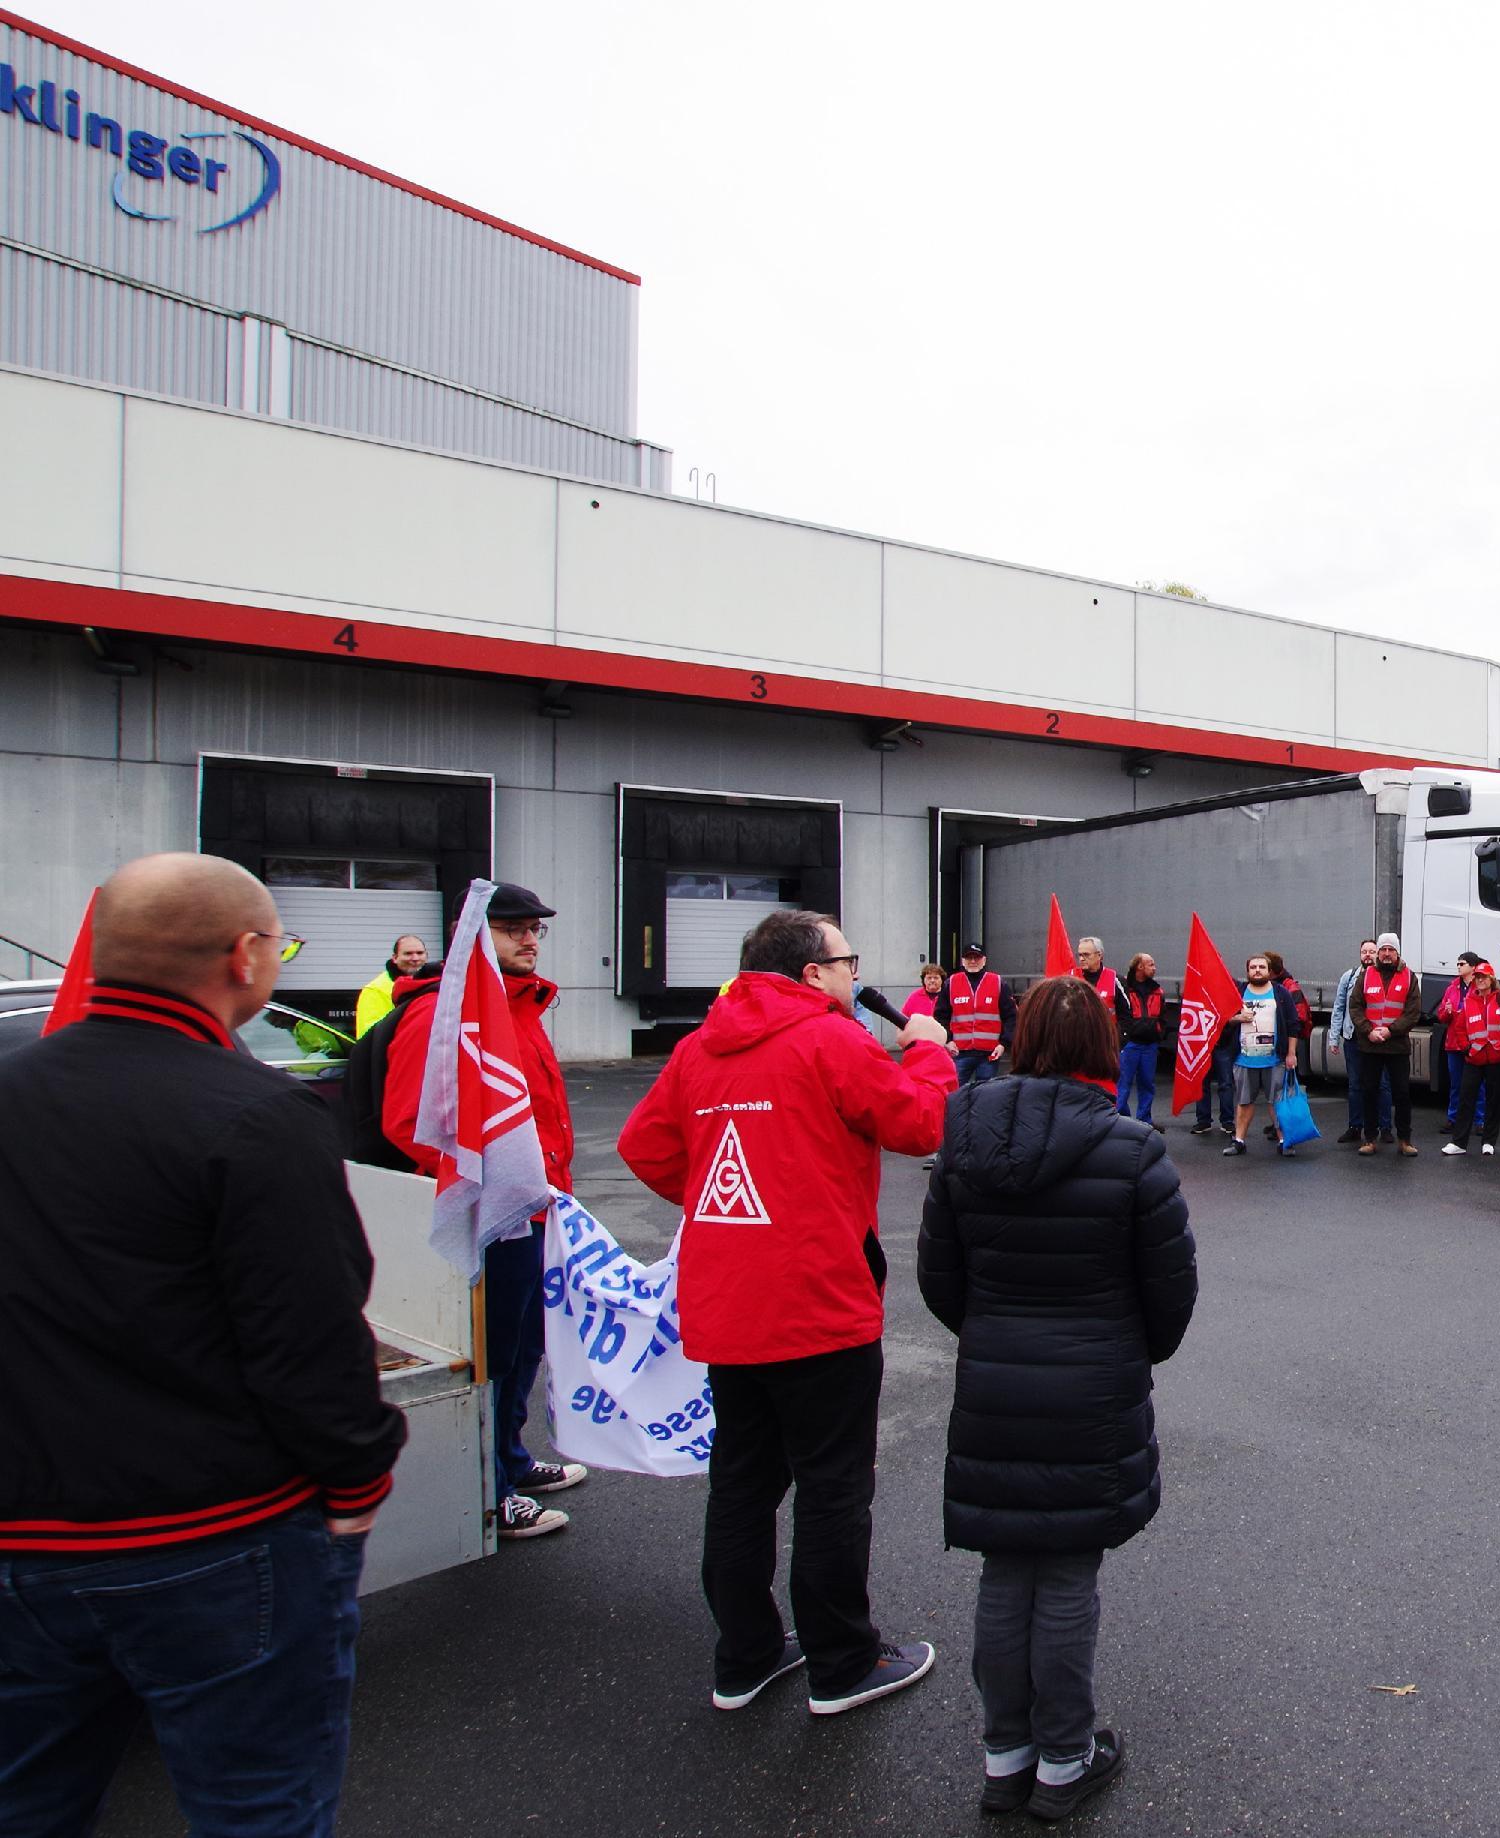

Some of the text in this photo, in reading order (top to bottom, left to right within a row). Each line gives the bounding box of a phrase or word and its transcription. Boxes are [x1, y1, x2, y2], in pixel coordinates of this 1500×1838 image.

[0, 62, 228, 193] klinger
[333, 623, 359, 652] 4
[751, 674, 768, 699] 3
[1046, 713, 1060, 734] 2
[1286, 745, 1294, 764] 1
